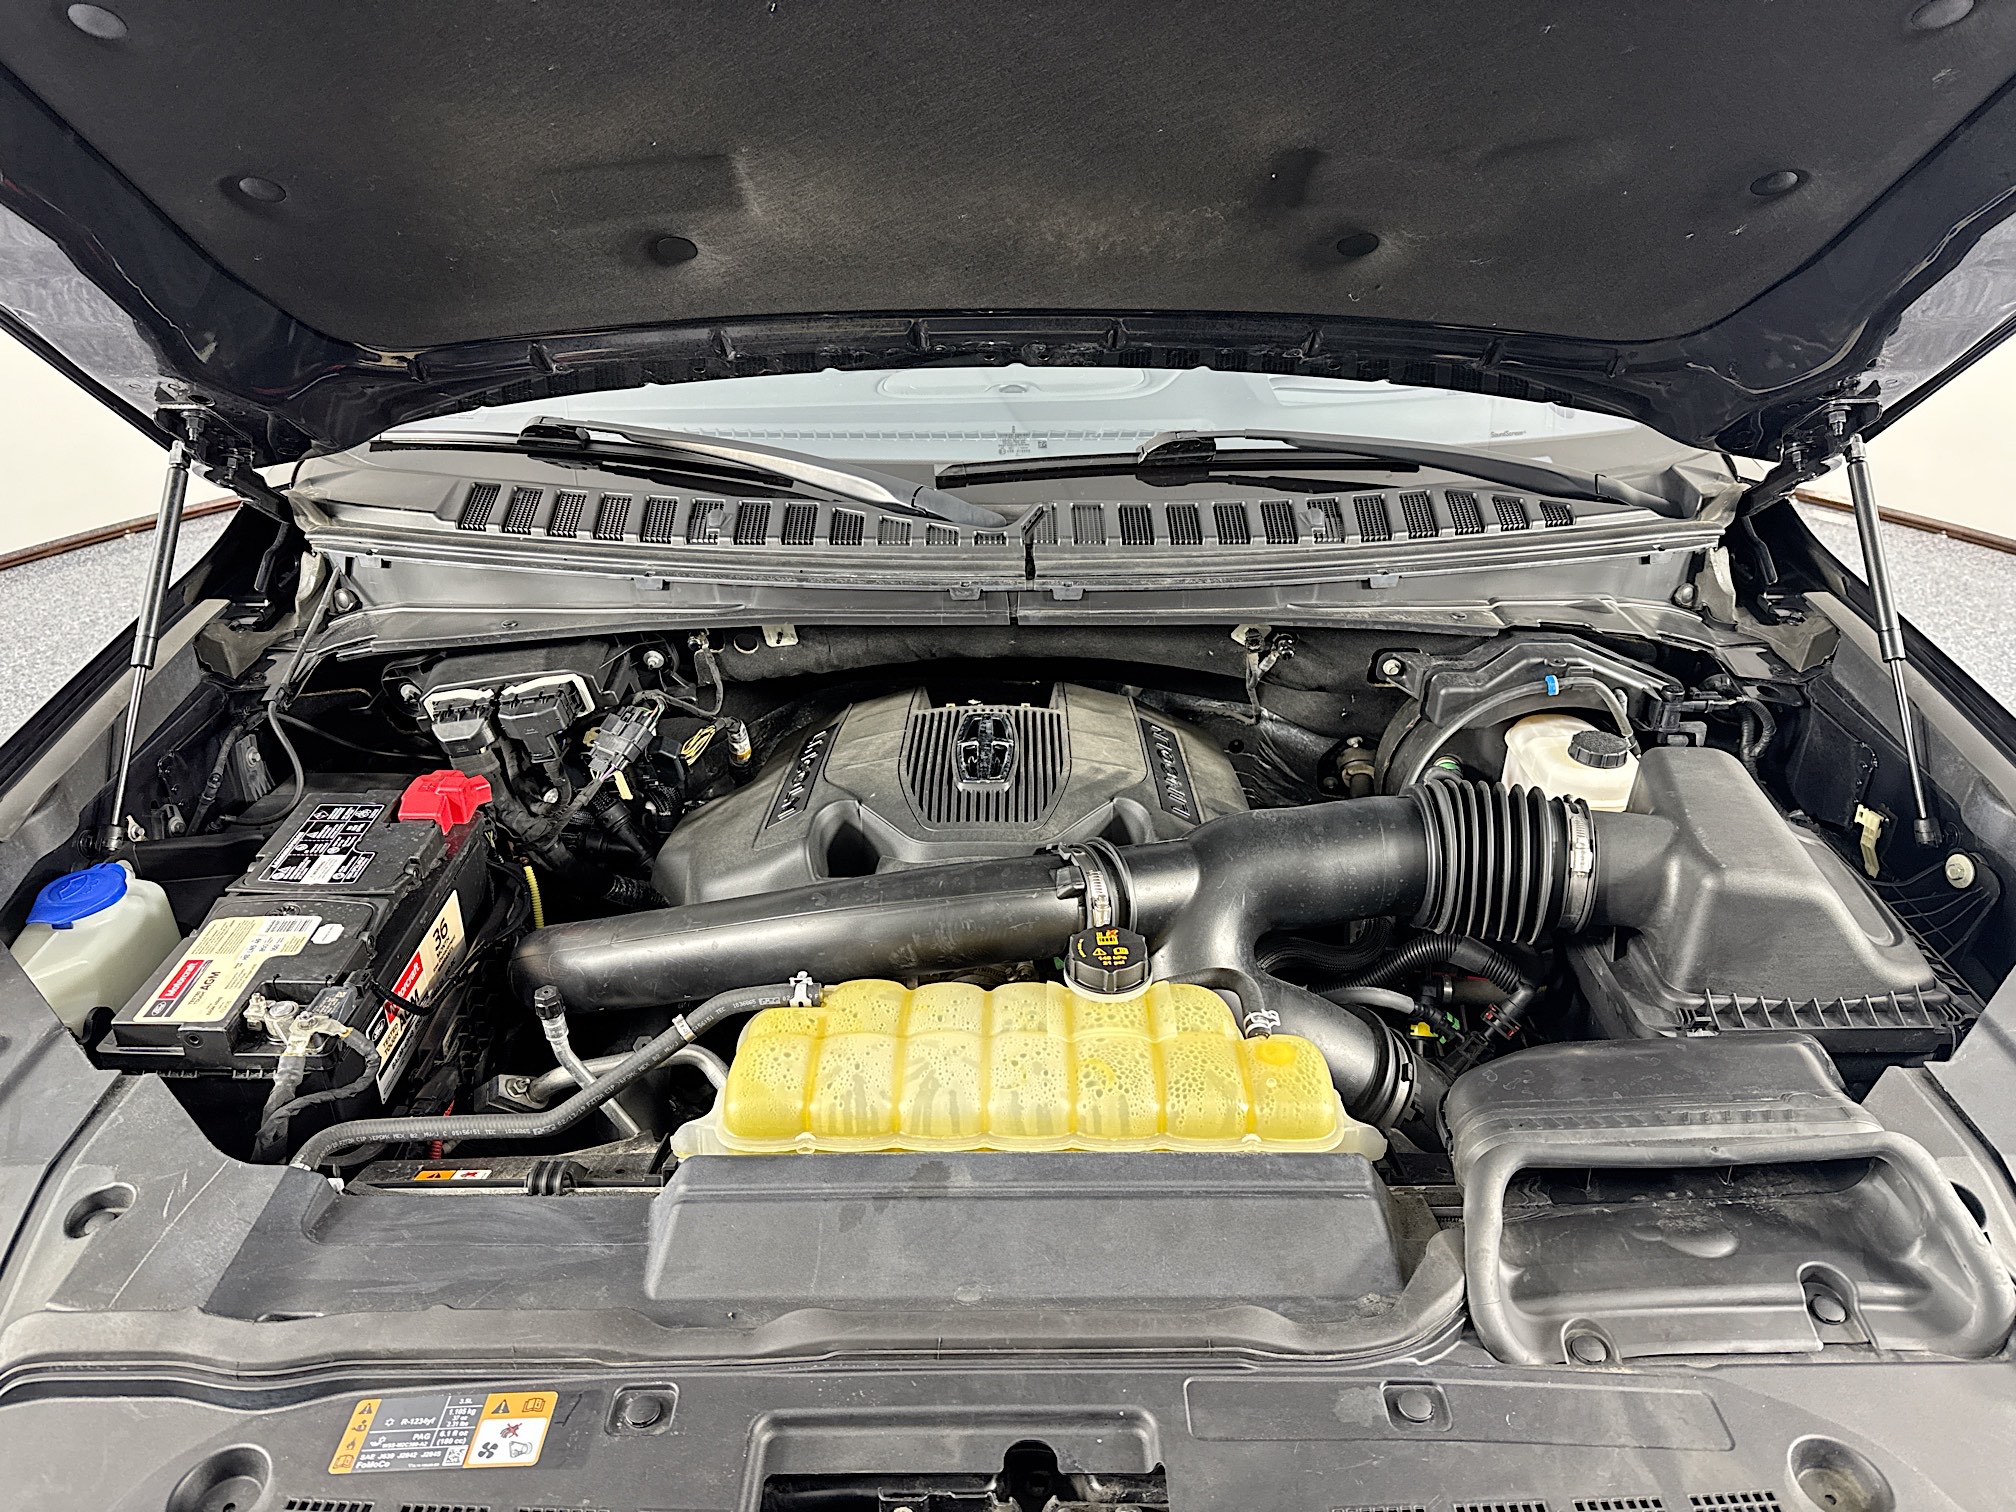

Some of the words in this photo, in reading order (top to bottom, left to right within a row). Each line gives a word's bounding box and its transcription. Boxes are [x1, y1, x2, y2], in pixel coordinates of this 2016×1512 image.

[433, 917, 448, 951] 36
[164, 962, 199, 997] Motorcraft
[200, 971, 221, 991] AGM
[412, 1433, 431, 1441] PAG
[356, 1460, 391, 1469] FoMoCo
